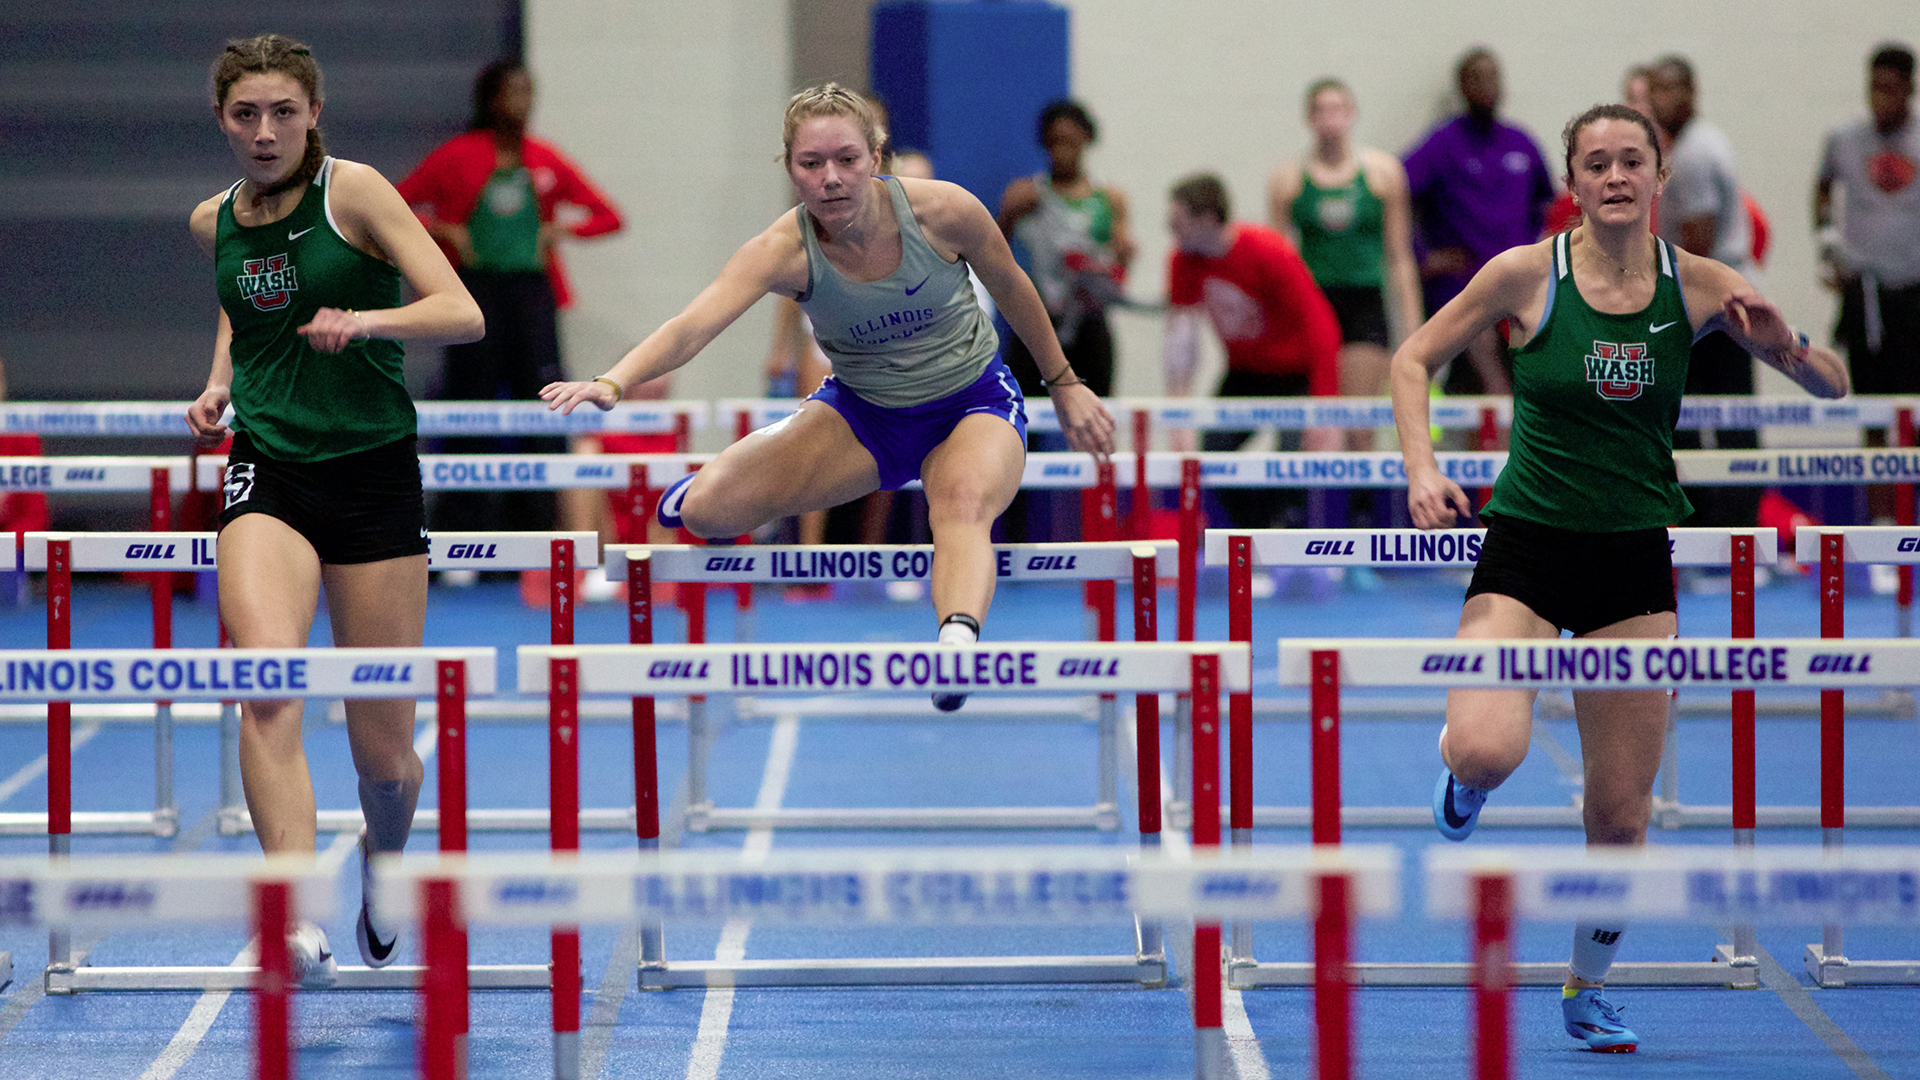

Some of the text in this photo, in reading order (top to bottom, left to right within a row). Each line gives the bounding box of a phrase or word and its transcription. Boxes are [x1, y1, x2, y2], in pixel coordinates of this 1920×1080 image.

[238, 267, 298, 299] WASH
[849, 308, 933, 338] ILLINOIS
[1585, 355, 1654, 384] WASH
[433, 462, 546, 482] COLLEGE
[1265, 459, 1371, 479] ILLINOIS
[1380, 459, 1493, 479] CEGE
[1778, 455, 1863, 477] ILLINOIS
[125, 544, 176, 559] GILL
[447, 544, 497, 559] GILL
[1304, 534, 1483, 562] GILL ILLINOIS
[705, 557, 755, 571] GILL
[771, 551, 882, 578] ILLINOIS
[1027, 555, 1076, 570] GILL
[0, 659, 412, 691] INOIS COLLEGE GILL
[648, 652, 1118, 686] GILL ILLINOIS COLLEGE GILL
[1421, 647, 1870, 680] GILL ILLINOIS COLLEGE GILL
